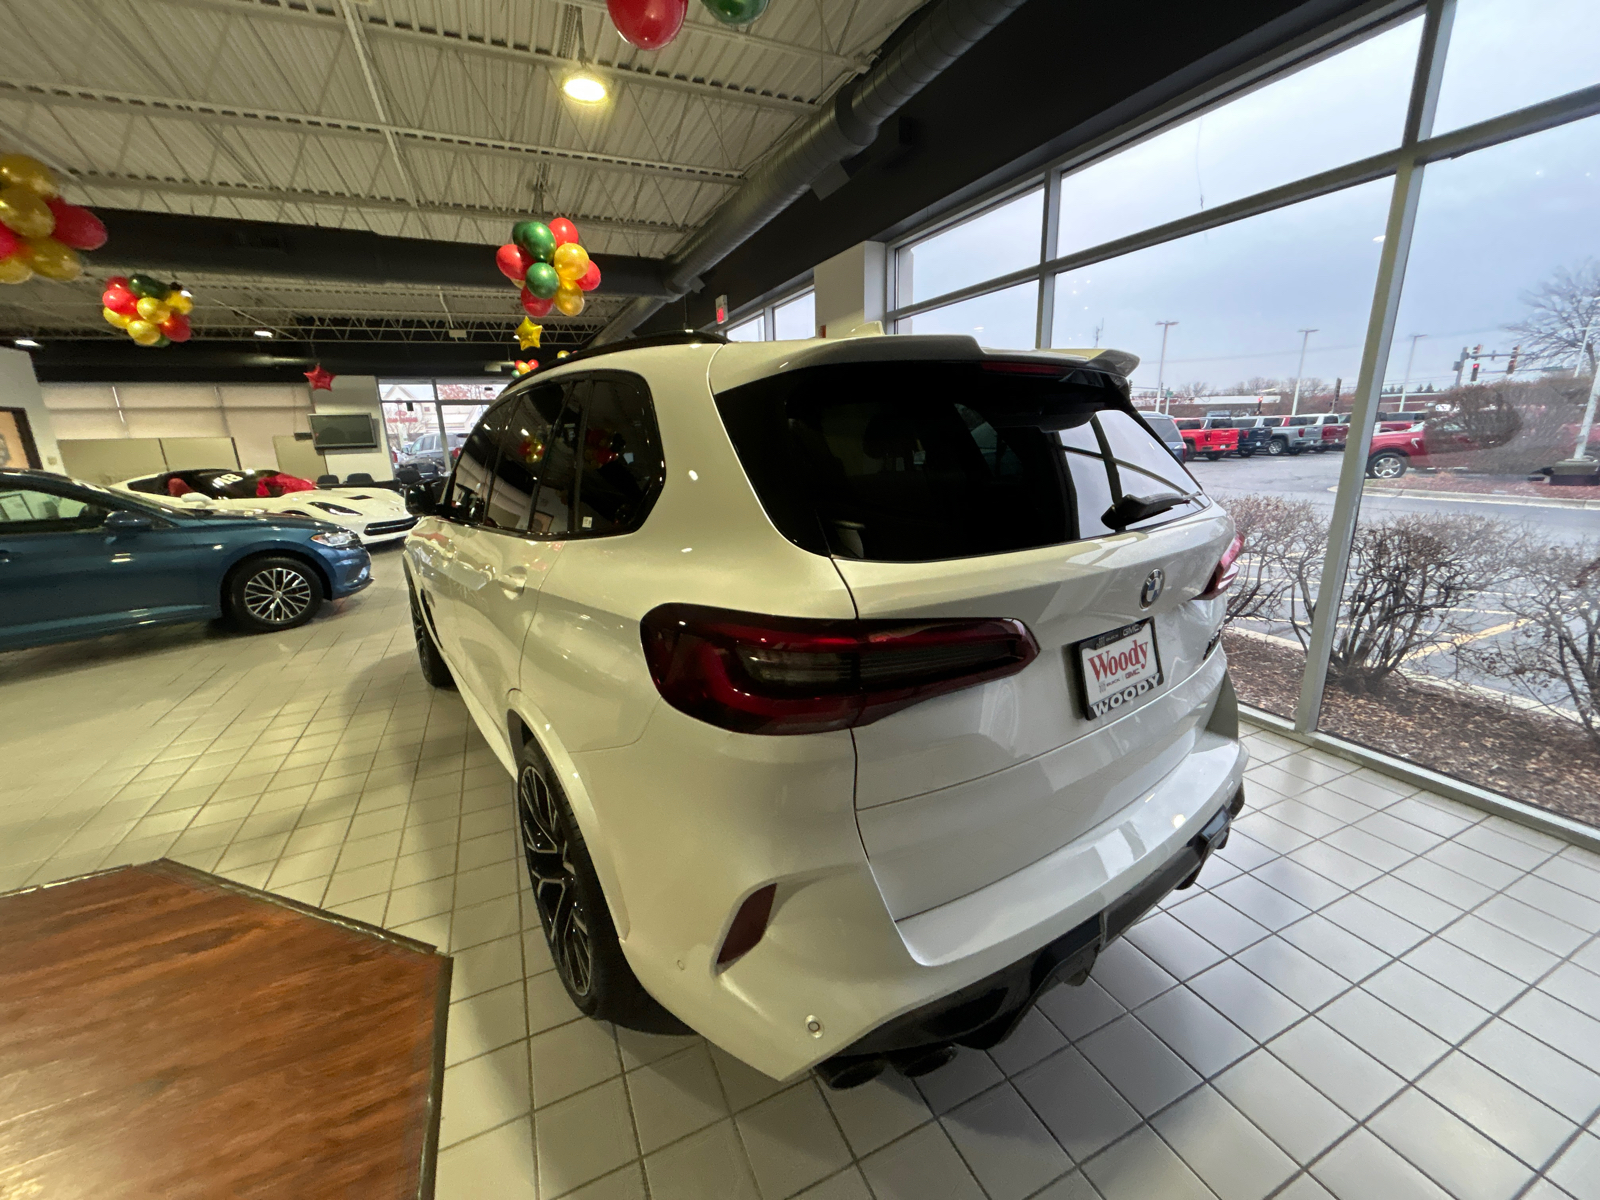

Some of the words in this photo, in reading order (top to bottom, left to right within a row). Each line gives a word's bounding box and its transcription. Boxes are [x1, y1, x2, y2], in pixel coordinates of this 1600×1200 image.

[1122, 623, 1140, 637] GMC
[1087, 639, 1149, 682] Woody
[1124, 667, 1141, 680] GMC
[1092, 672, 1160, 718] WOODY
